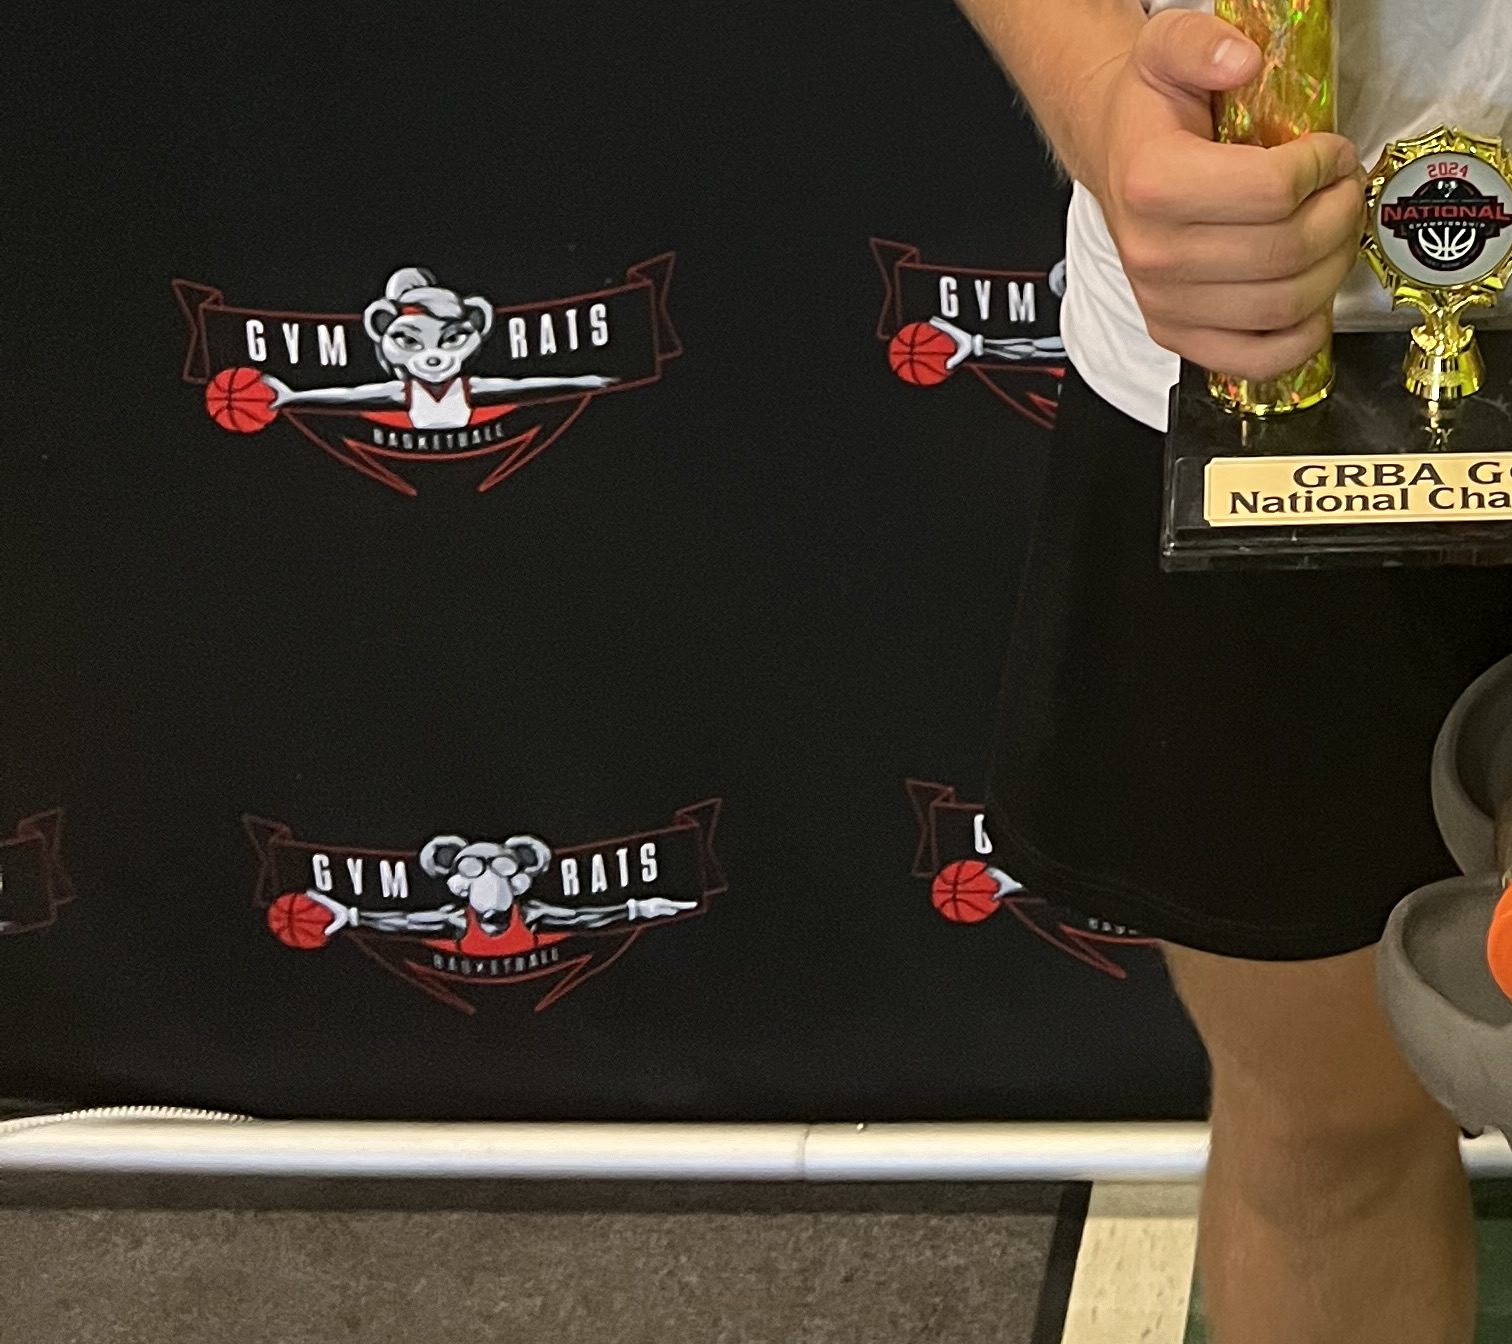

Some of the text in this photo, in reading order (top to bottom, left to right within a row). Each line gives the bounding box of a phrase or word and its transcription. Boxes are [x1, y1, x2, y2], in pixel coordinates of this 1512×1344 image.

[1427, 162, 1469, 179] 2024
[1384, 204, 1511, 222] NATIONAL
[940, 276, 1035, 322] GYM
[246, 304, 608, 366] GYM RATS
[1293, 461, 1444, 488] GRBA
[1230, 487, 1409, 515] National
[313, 843, 657, 898] GYM RATS
